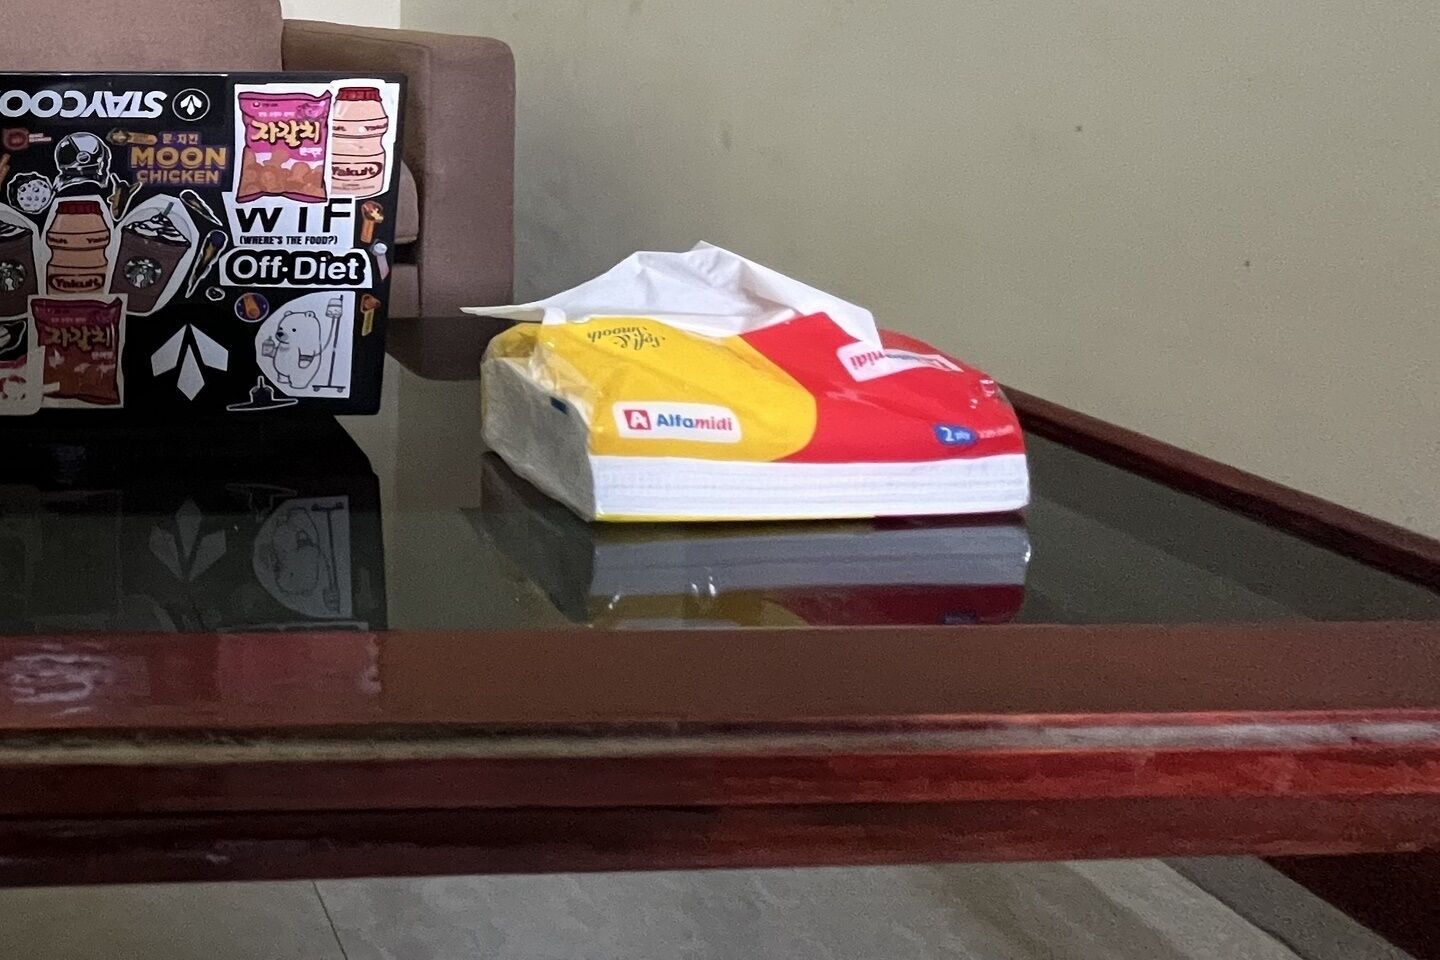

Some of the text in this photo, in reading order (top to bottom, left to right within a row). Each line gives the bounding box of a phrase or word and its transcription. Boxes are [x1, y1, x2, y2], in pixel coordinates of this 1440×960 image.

[130, 147, 227, 170] MOON
[136, 170, 220, 184] CHICKEN
[239, 235, 338, 245] (WHERE'S THE FOOD?)
[587, 326, 648, 343] Smooth
[656, 413, 733, 431] Alfamidi
[939, 426, 955, 442] 2
